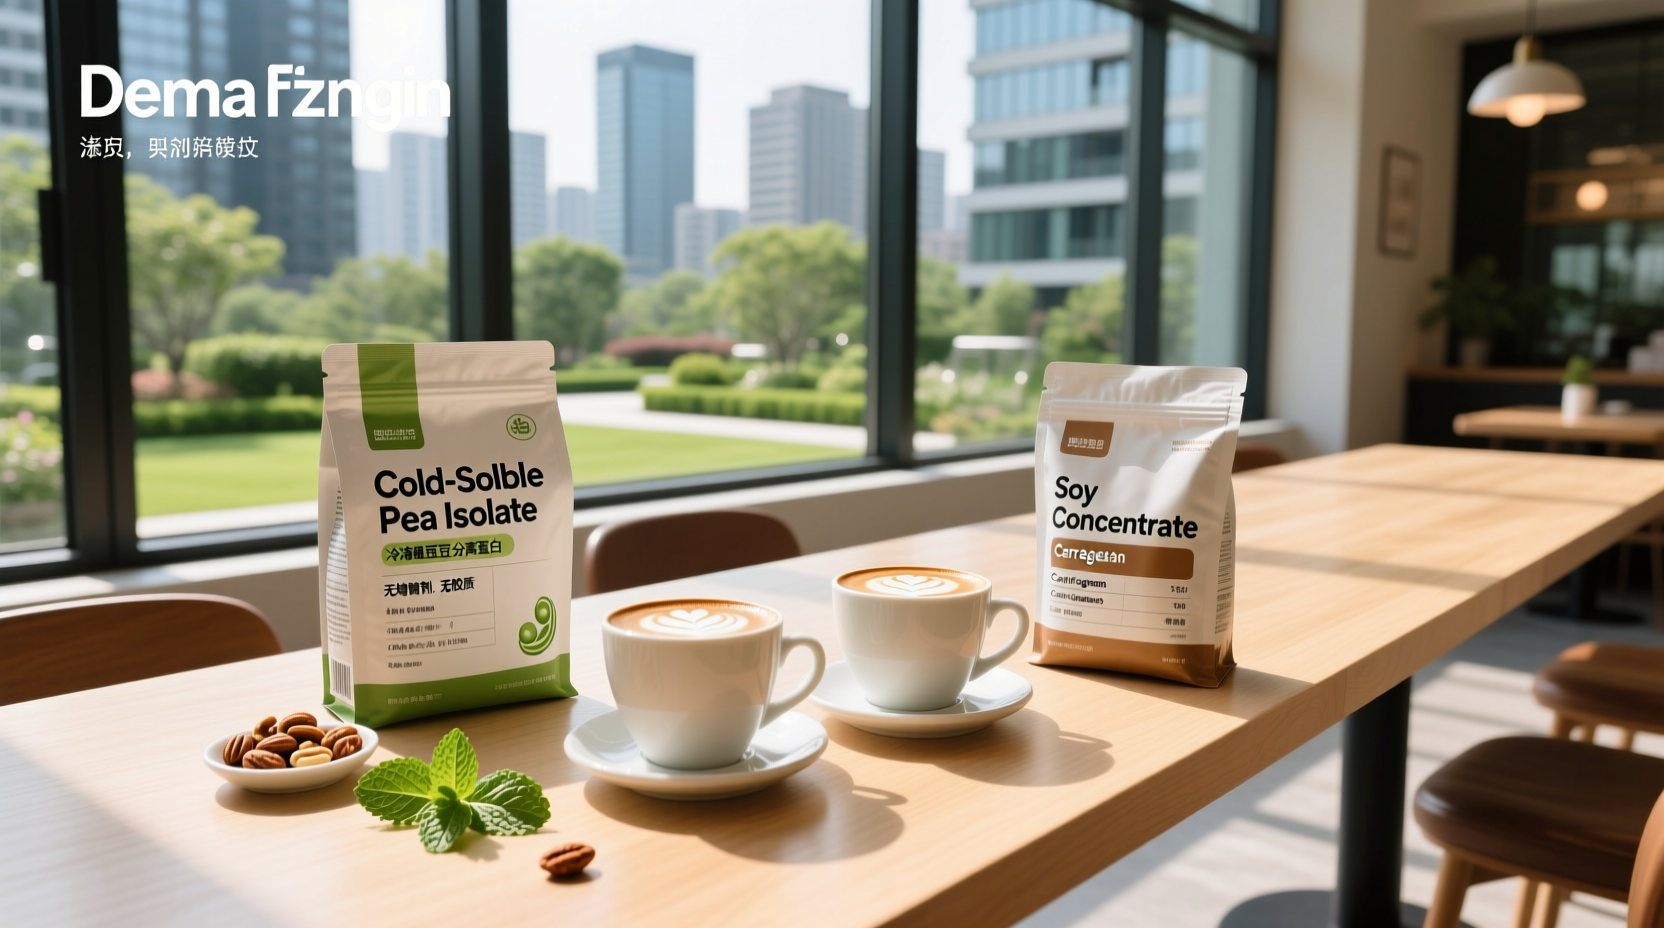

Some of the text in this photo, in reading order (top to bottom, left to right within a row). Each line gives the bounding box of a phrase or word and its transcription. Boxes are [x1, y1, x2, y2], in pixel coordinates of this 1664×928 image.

[374, 461, 544, 499] Cold-Solble
[1054, 475, 1099, 508] Soy
[379, 498, 538, 534] Pea Isolate
[1052, 506, 1199, 539] Concentrate
